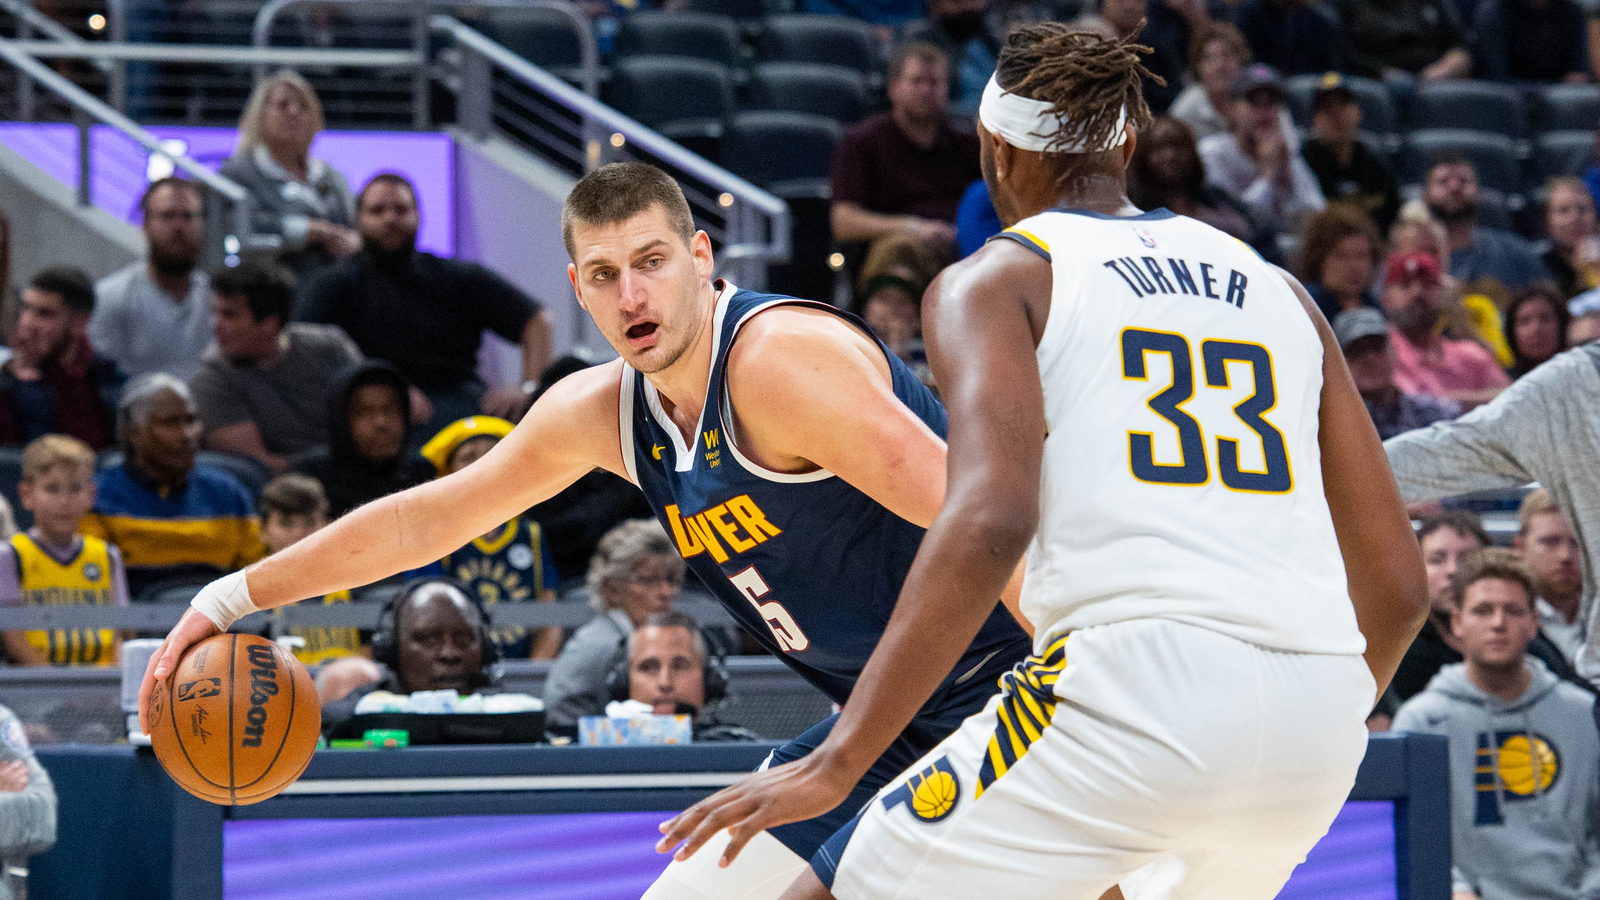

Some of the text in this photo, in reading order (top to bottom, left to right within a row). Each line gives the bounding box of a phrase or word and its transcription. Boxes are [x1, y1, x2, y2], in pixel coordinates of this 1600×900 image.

[1103, 256, 1248, 309] TURNER
[1119, 326, 1295, 495] 33
[727, 564, 810, 652] 5
[241, 645, 279, 748] Wilson
